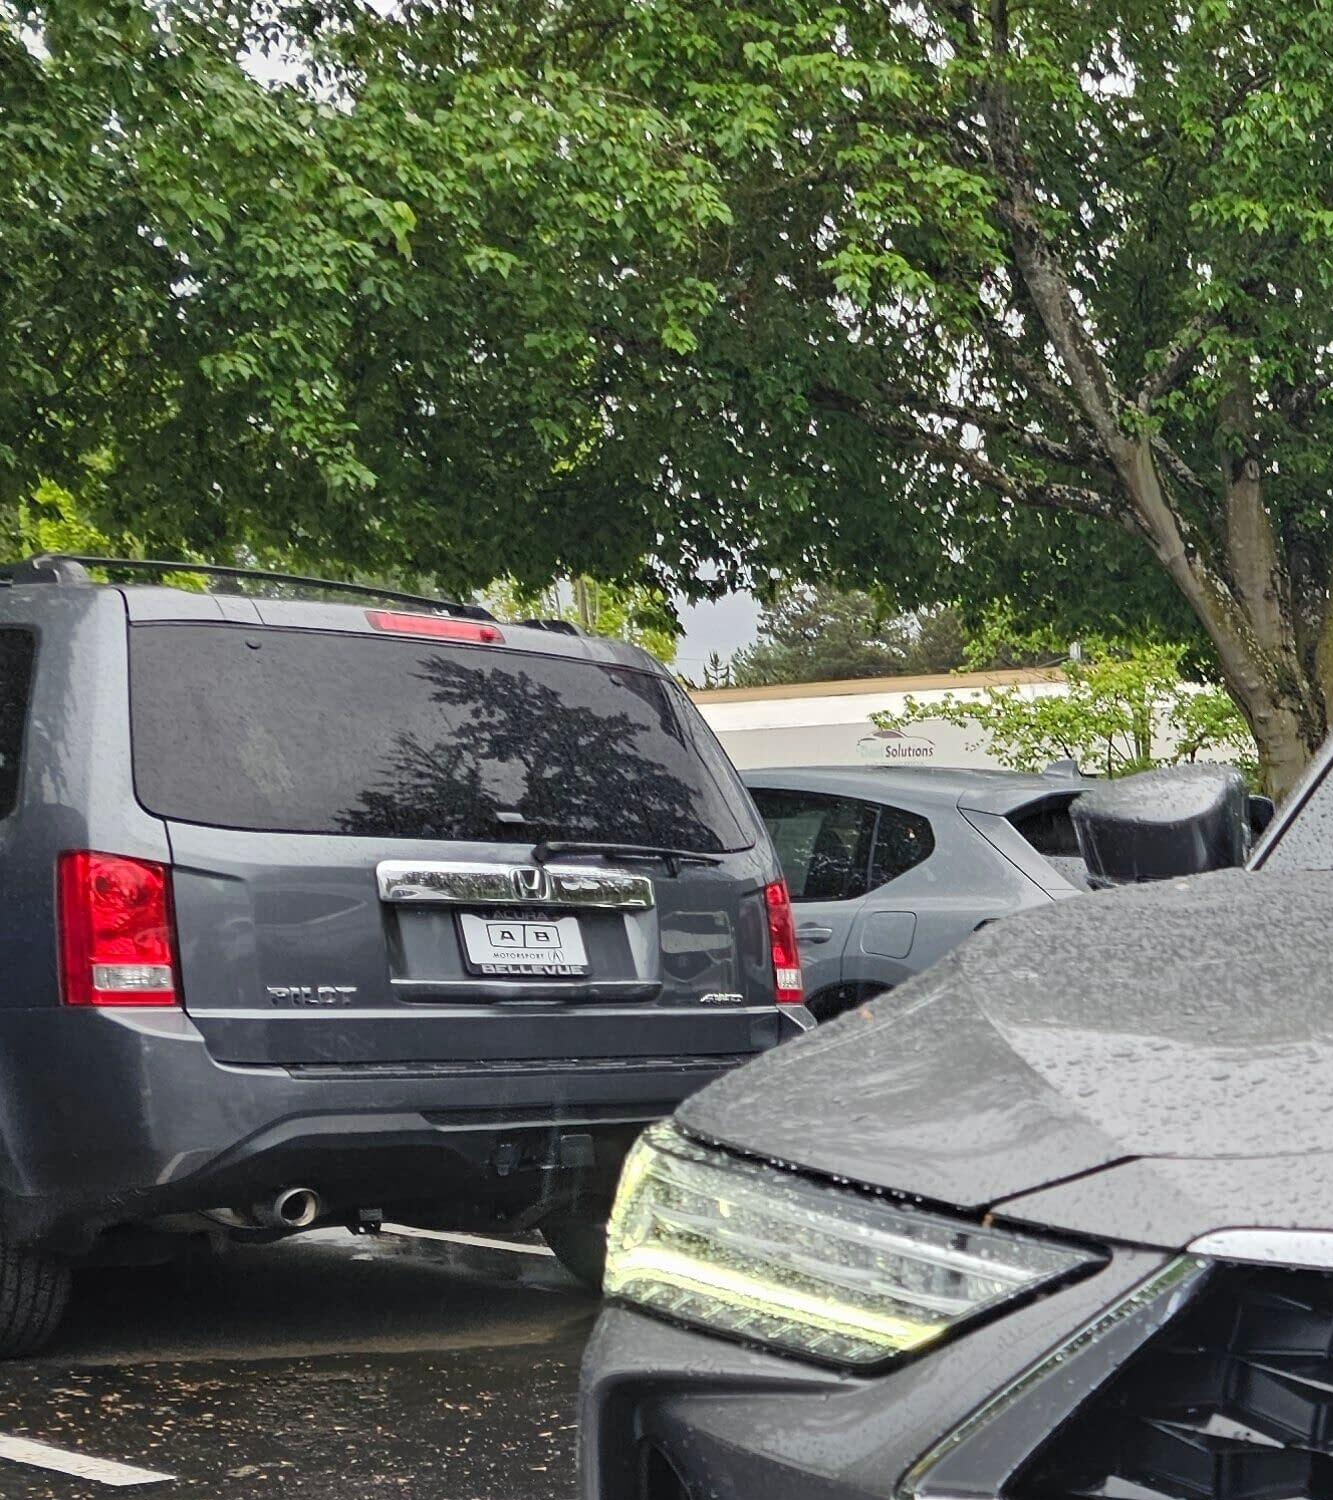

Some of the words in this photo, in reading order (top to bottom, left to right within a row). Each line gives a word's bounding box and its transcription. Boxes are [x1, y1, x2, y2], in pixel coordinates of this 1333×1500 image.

[884, 743, 935, 759] Solutions
[493, 910, 549, 921] ACURA
[500, 930, 516, 941] A
[533, 931, 550, 942] B
[493, 952, 544, 960] MOTORSPORT
[481, 964, 585, 975] BELLEVUE
[266, 986, 358, 1006] PILOT
